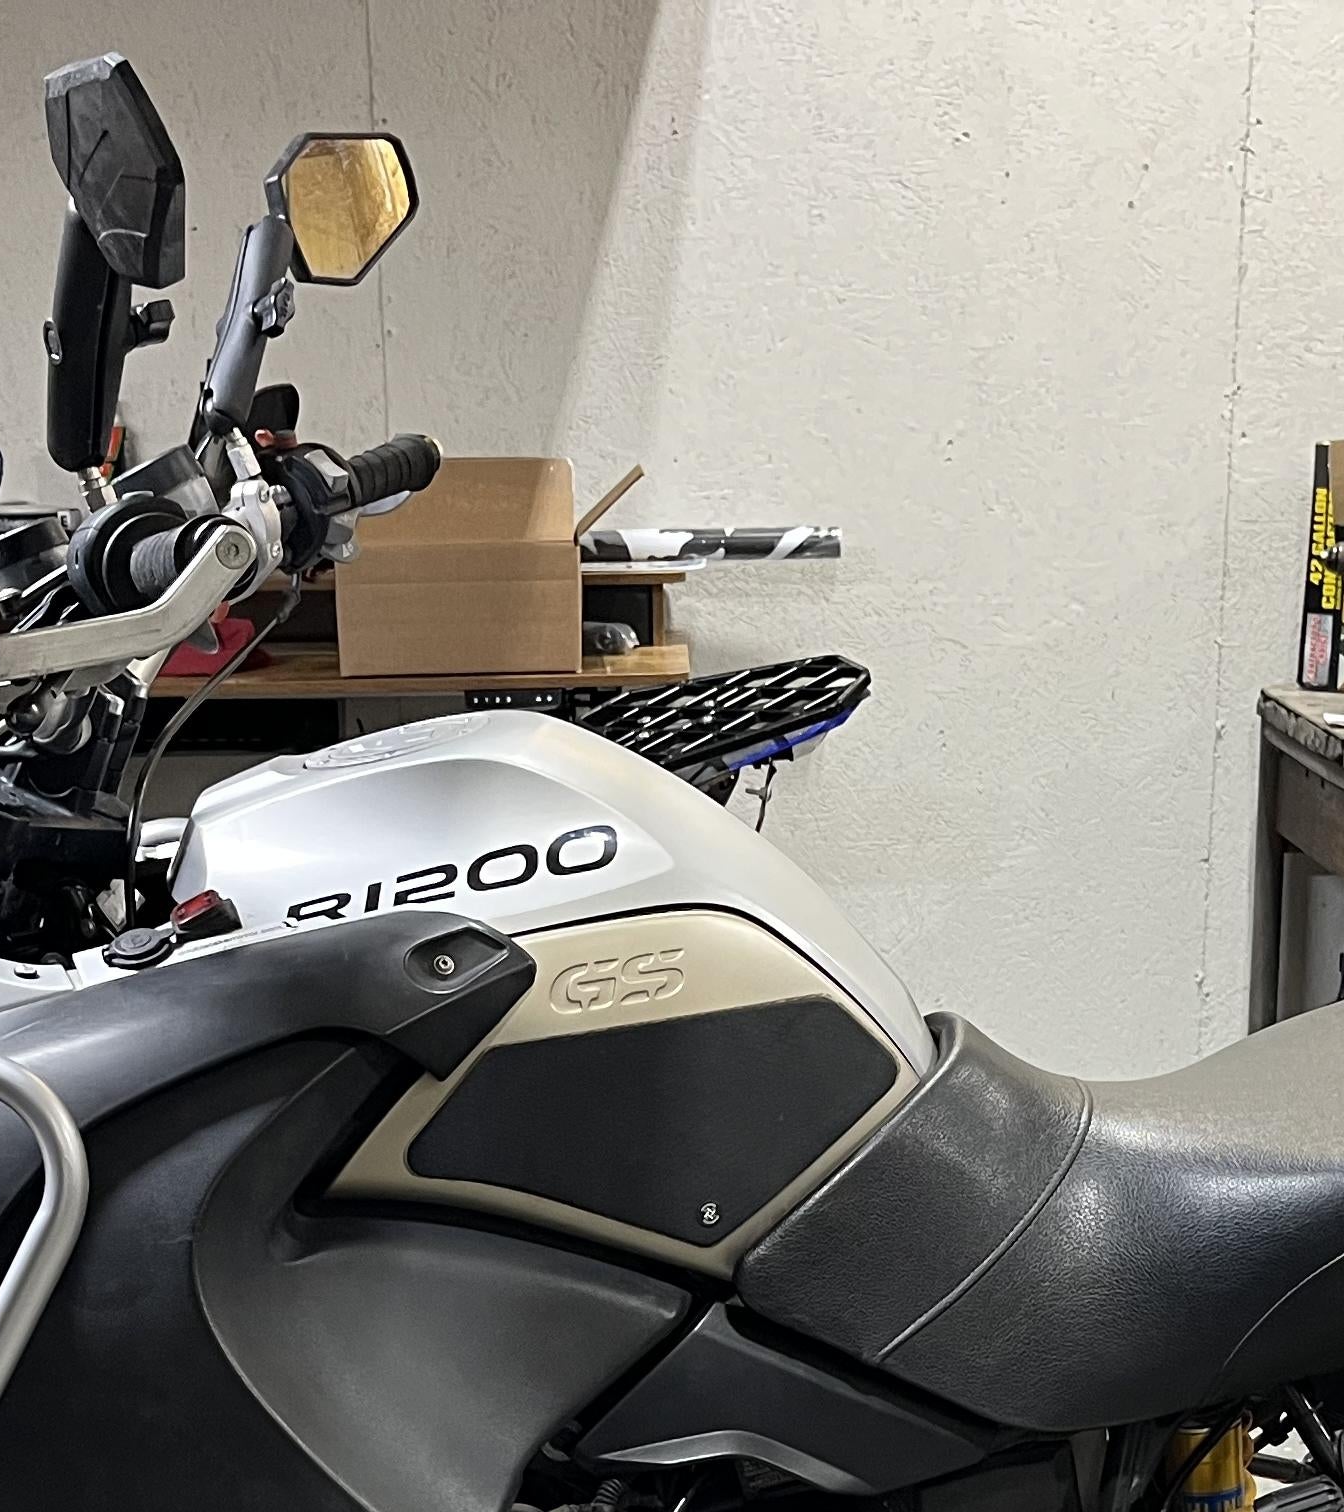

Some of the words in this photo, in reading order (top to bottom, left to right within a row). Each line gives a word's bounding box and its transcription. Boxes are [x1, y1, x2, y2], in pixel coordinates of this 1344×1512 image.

[1311, 487, 1328, 556] GALLON
[1309, 558, 1323, 586] 42
[286, 824, 618, 922] R1200
[549, 947, 686, 1016] GS
